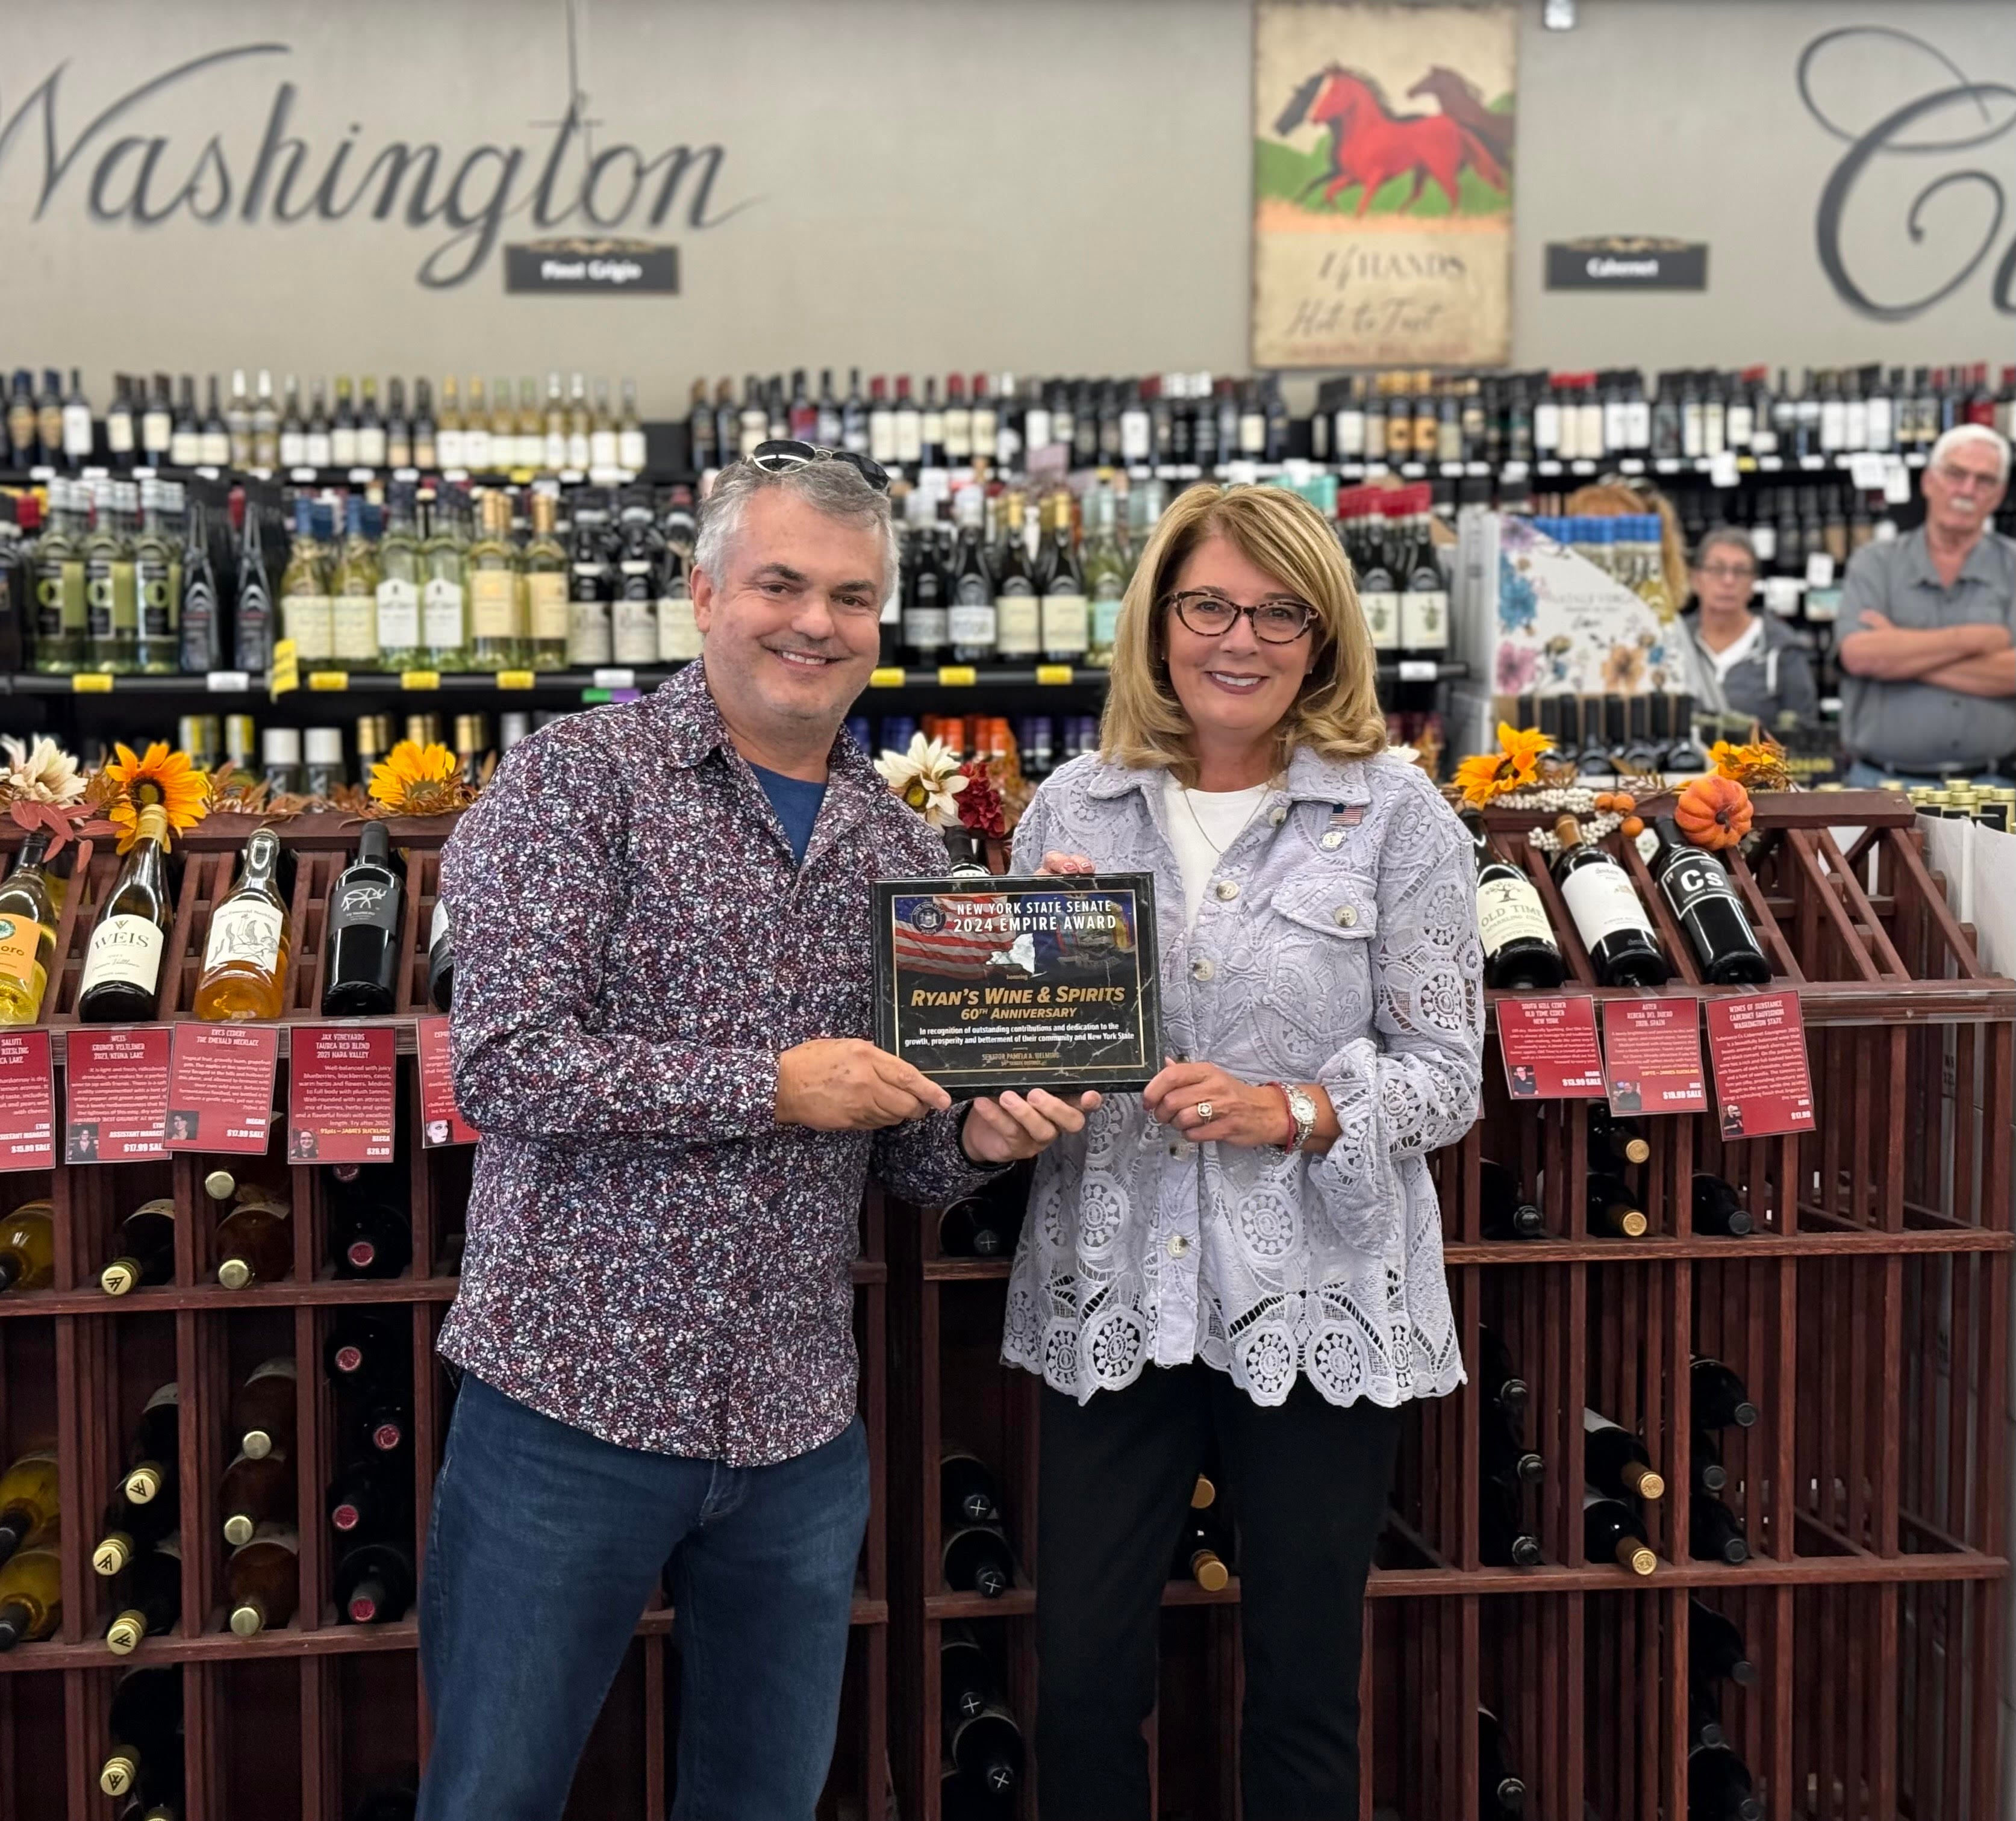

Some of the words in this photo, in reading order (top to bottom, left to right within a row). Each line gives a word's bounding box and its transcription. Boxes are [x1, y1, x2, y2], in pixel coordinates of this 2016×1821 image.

[542, 259, 585, 279] Pinot
[588, 260, 641, 284] Grigio
[1587, 257, 1658, 278] Cabernet
[1681, 869, 1724, 892] Cs
[957, 904, 987, 915] NEW
[988, 903, 1022, 915] YORK
[1026, 901, 1061, 914] STATE
[1066, 900, 1111, 913] SENATE
[1481, 908, 1506, 927] OLD
[1510, 904, 1544, 918] TIME
[953, 918, 993, 933] 2024
[999, 917, 1057, 932] EMPIRE
[1064, 915, 1116, 930] AWARD
[95, 932, 149, 950] WEIS
[1037, 986, 1050, 1003] &
[990, 1007, 1078, 1019] ANNIVERSARY
[927, 1026, 963, 1036] recognition
[972, 1026, 1010, 1035] outstanding
[1011, 1024, 1052, 1033] contributions
[905, 1038, 930, 1047] growth,
[931, 1036, 963, 1046] prosperity
[978, 1035, 1013, 1044] betterment
[1038, 1033, 1073, 1042] community
[1117, 1032, 1135, 1040] State
